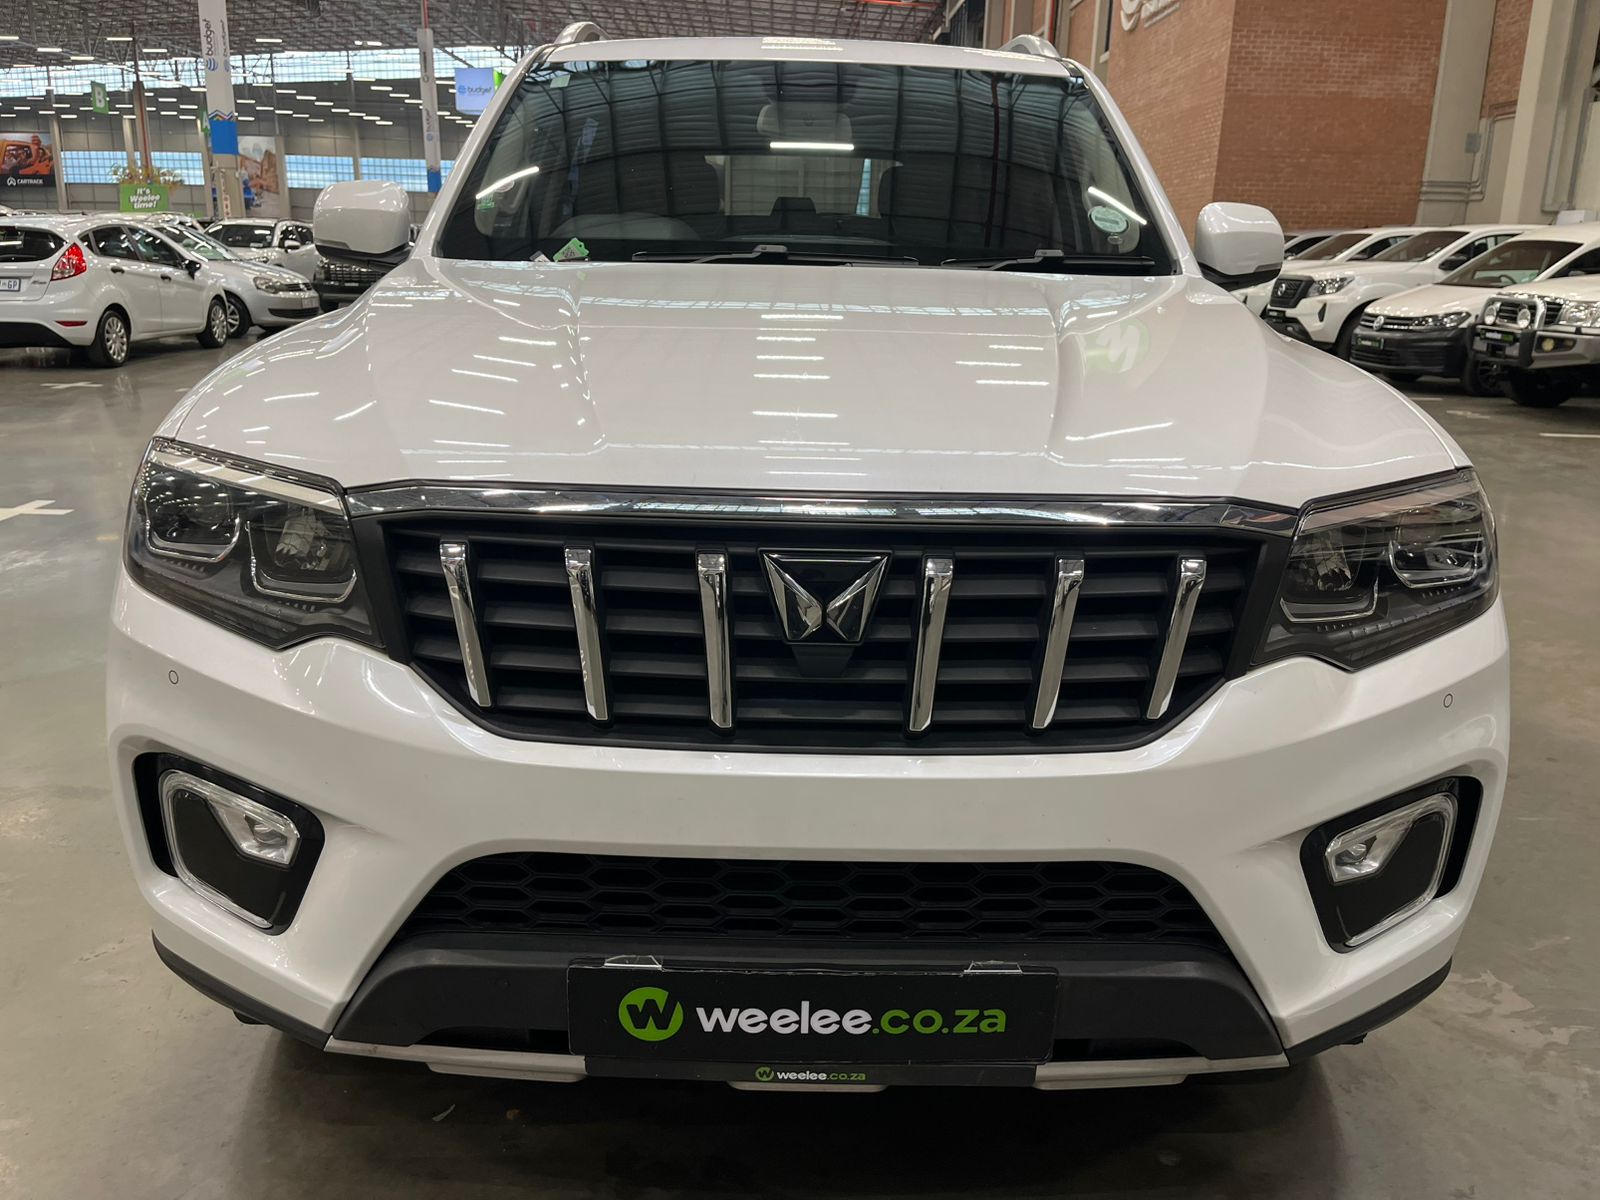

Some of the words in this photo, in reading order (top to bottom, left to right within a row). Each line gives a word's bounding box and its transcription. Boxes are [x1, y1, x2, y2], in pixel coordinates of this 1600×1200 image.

[202, 18, 215, 57] budget
[467, 85, 492, 95] budget
[95, 86, 106, 109] B
[137, 187, 151, 195] It's
[133, 201, 157, 209] time!
[695, 1000, 1007, 1035] weelee.co.za
[776, 1070, 866, 1081] weelee.co.za
